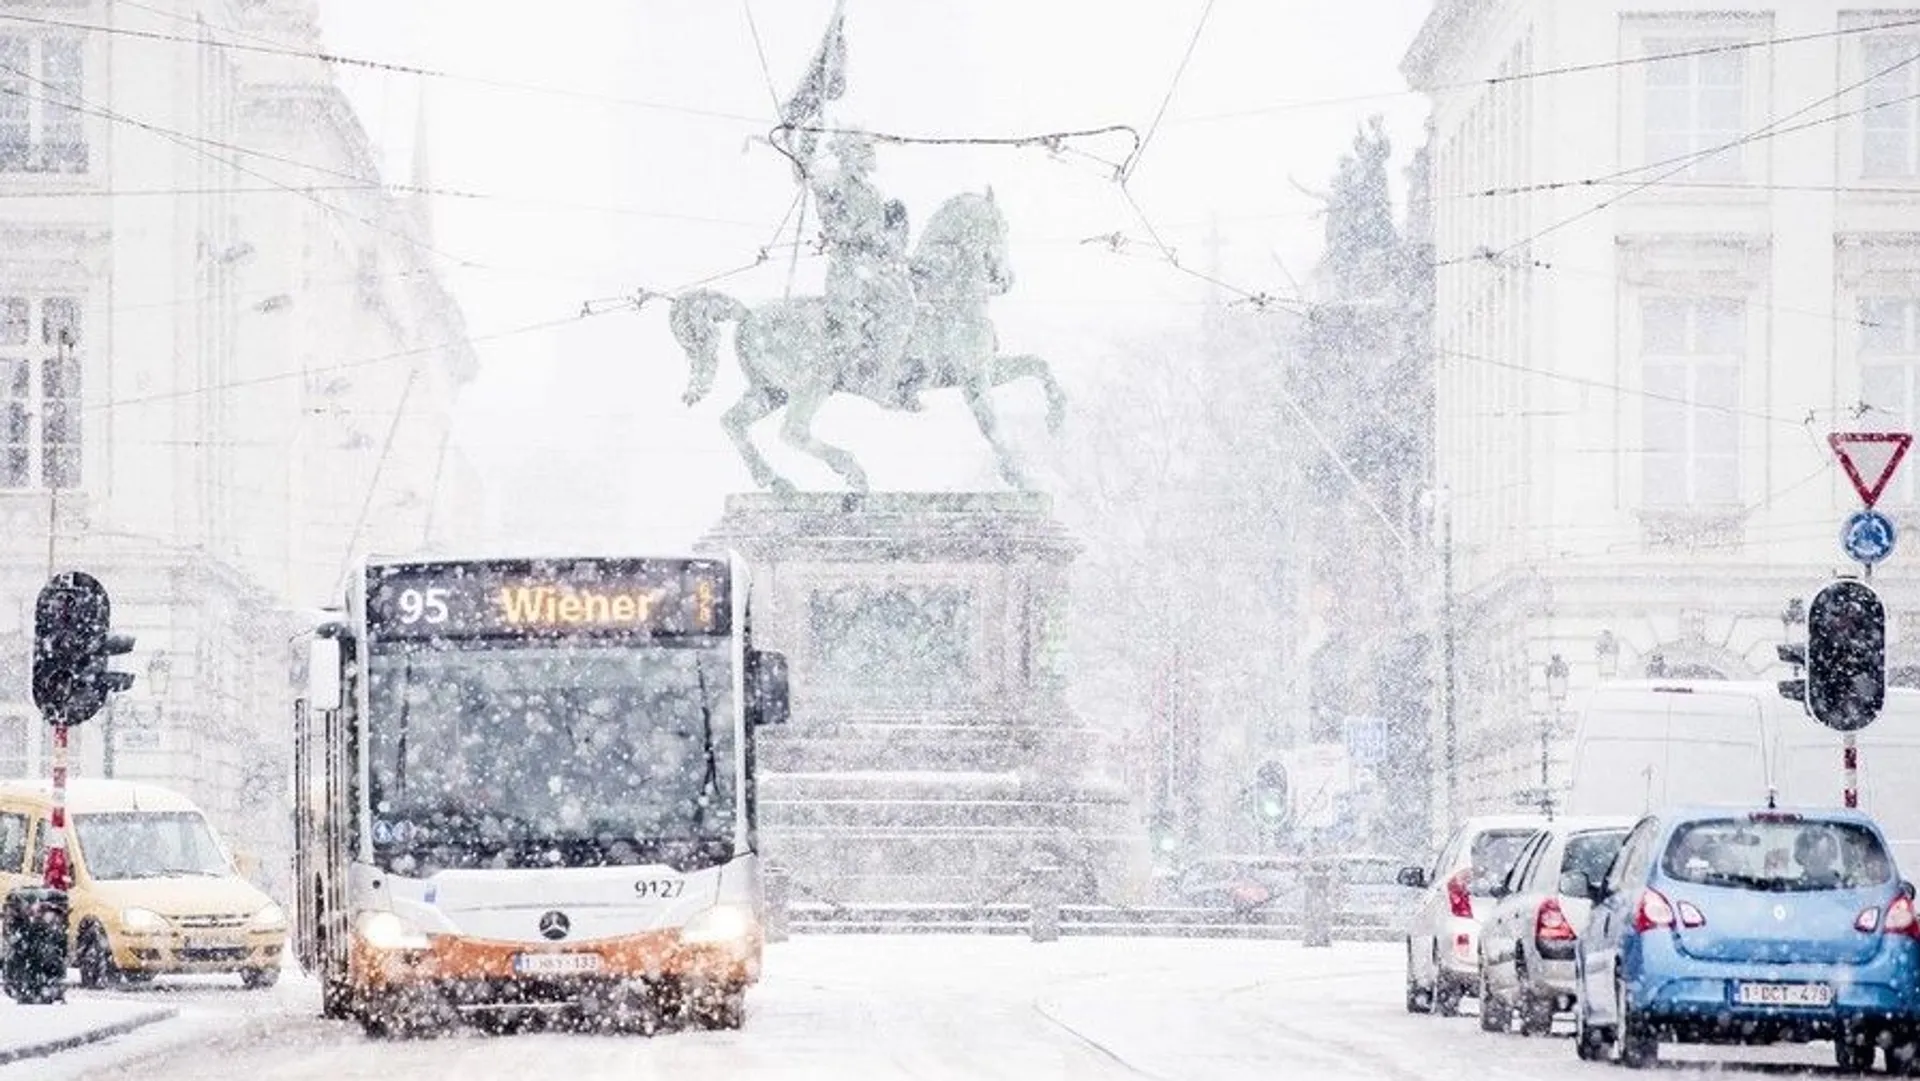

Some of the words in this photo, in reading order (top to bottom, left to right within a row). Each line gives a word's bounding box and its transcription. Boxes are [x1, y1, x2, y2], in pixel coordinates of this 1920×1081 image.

[400, 588, 449, 624] 95
[502, 586, 655, 623] Wiener
[634, 879, 685, 898] 9127
